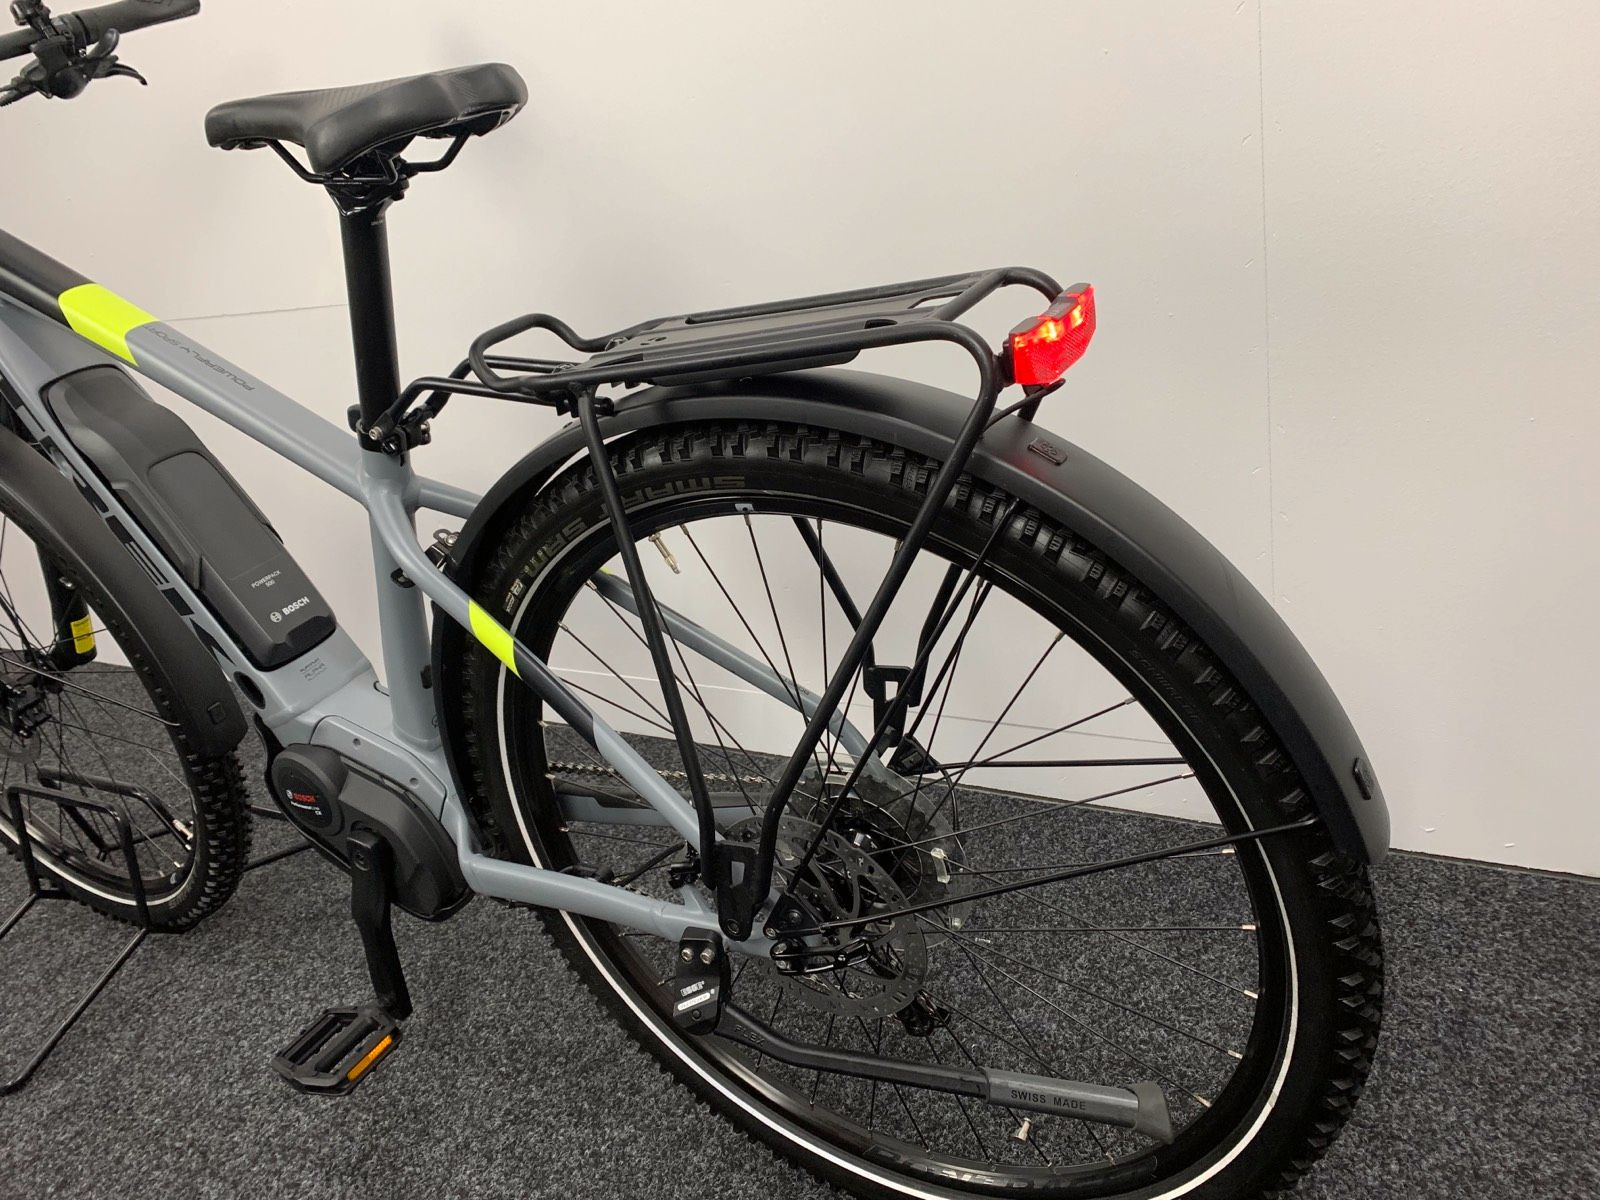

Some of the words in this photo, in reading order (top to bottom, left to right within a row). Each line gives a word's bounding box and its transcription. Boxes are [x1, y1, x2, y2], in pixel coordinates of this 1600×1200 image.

[251, 570, 281, 589] POWERPACK
[282, 596, 310, 616] BOSCH
[1010, 1089, 1046, 1104] SWISS
[1053, 1097, 1087, 1111] MADE
